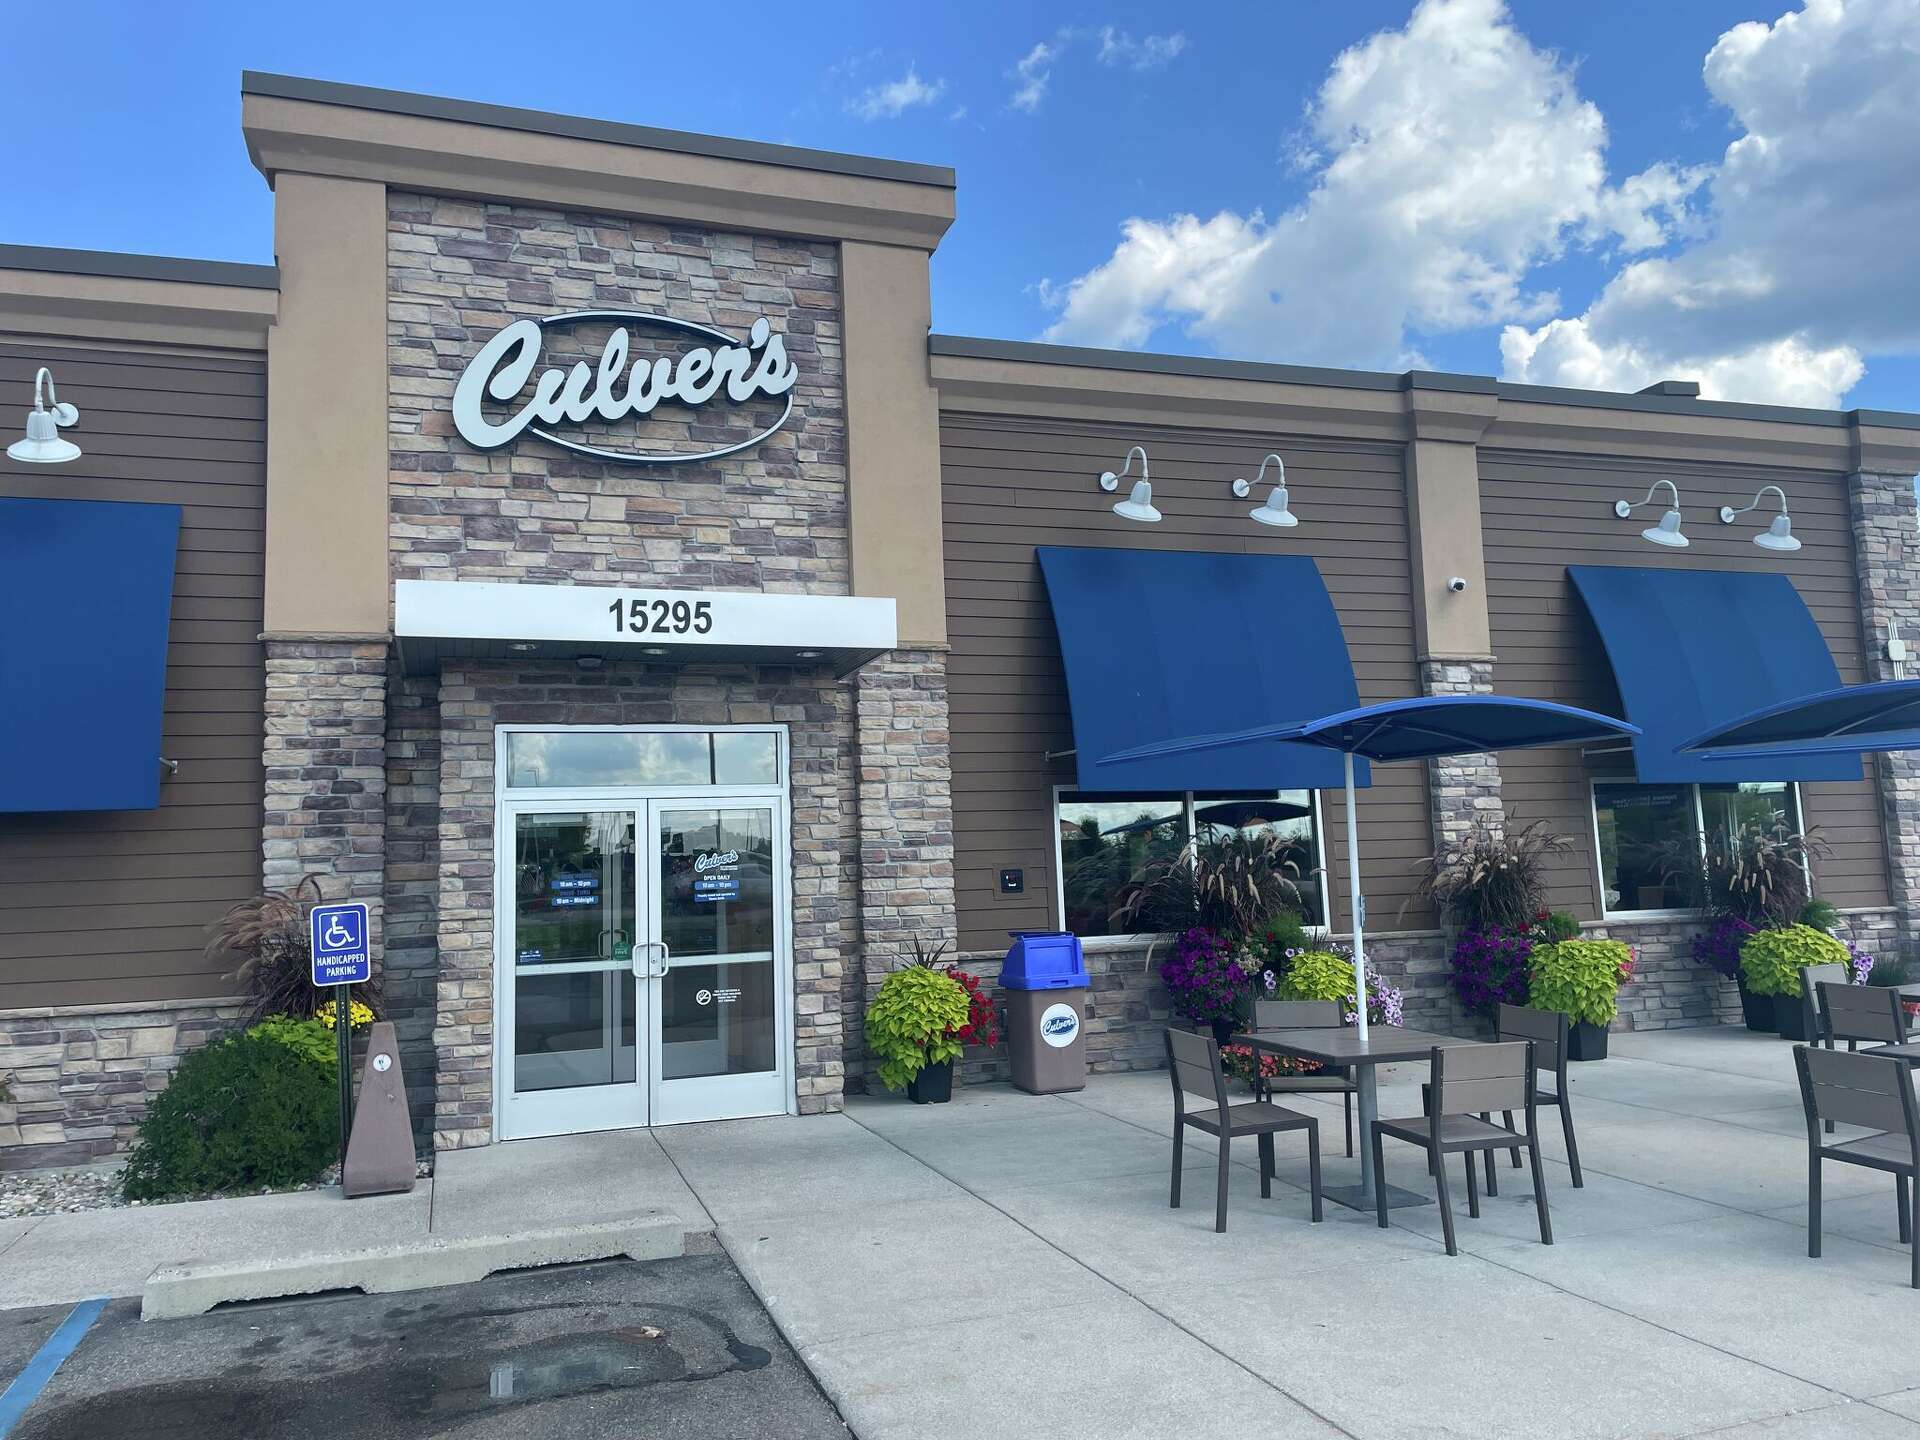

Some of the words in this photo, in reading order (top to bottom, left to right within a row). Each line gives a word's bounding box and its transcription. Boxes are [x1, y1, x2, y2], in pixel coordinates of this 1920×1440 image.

[452, 317, 799, 448] Culver's
[608, 598, 713, 635] 15295
[695, 850, 739, 873] Culver's
[316, 953, 365, 967] HANDICAPPED
[326, 965, 357, 977] PARKING
[1043, 1015, 1077, 1036] Culver's
